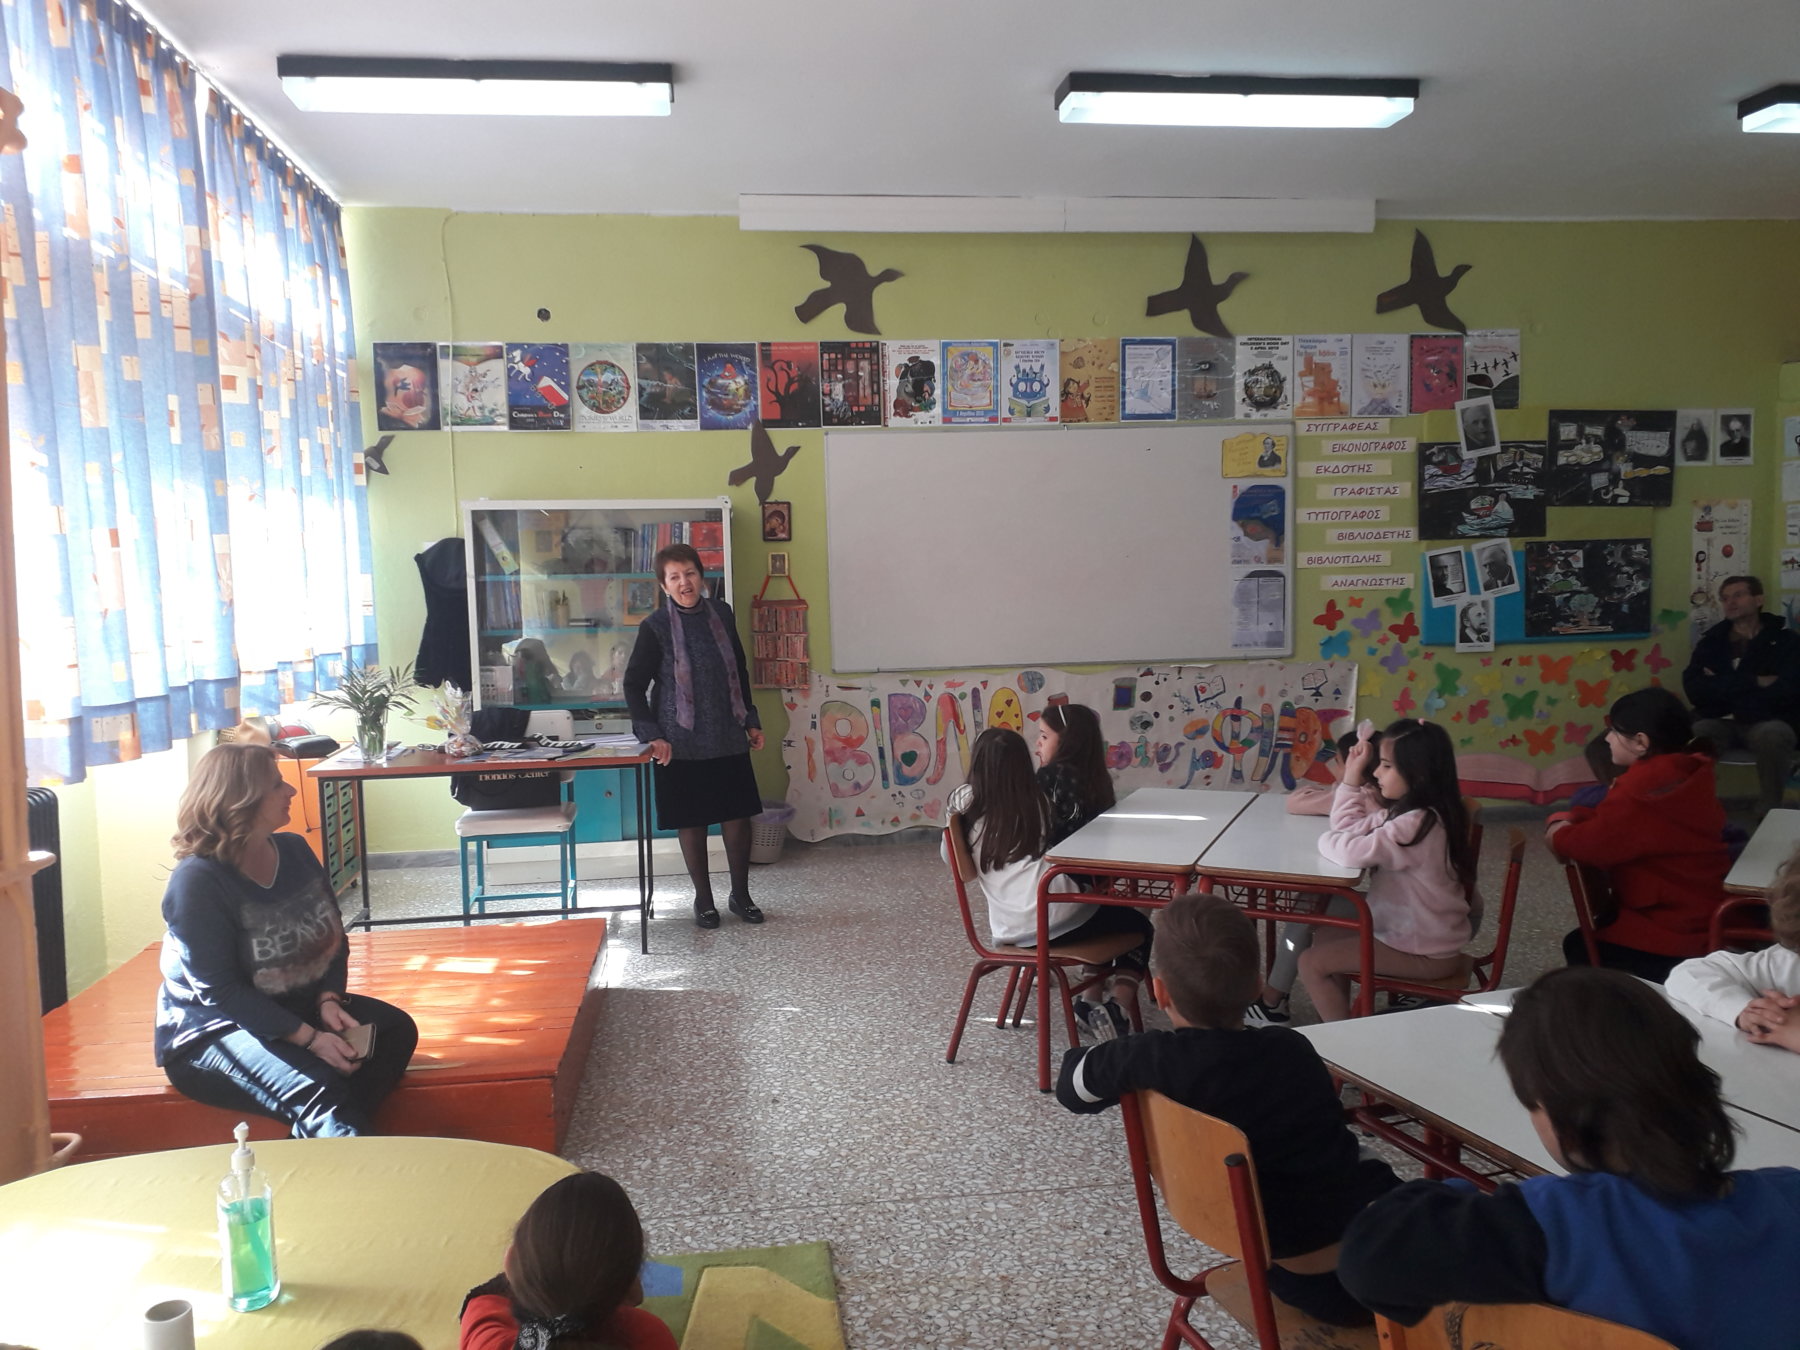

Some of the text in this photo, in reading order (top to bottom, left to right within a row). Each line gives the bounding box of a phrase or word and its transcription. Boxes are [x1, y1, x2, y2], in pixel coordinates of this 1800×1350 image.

[1306, 421, 1379, 432] ΣΥΓΓΡΑΦΕΑΣ
[1332, 440, 1408, 453] ΕΙΚΟΝΟΓΡΑΦΟΣ
[1315, 463, 1373, 475] ΕΚΔΟΤΗΣ
[1333, 486, 1400, 496] ΓΡΑΦΙΣΤΑΣ
[1306, 509, 1382, 521] ΤΥΠΟΓΡΑΦΟΣ
[1337, 530, 1412, 541] ΒΙΒΛΙΟΔΕΤΗΣ
[1306, 554, 1383, 566] ΒΙΒΛΙΟΠΩΛΗΣ
[1331, 577, 1406, 588] ΑΝΑΓΝΩΣΤΗΣ
